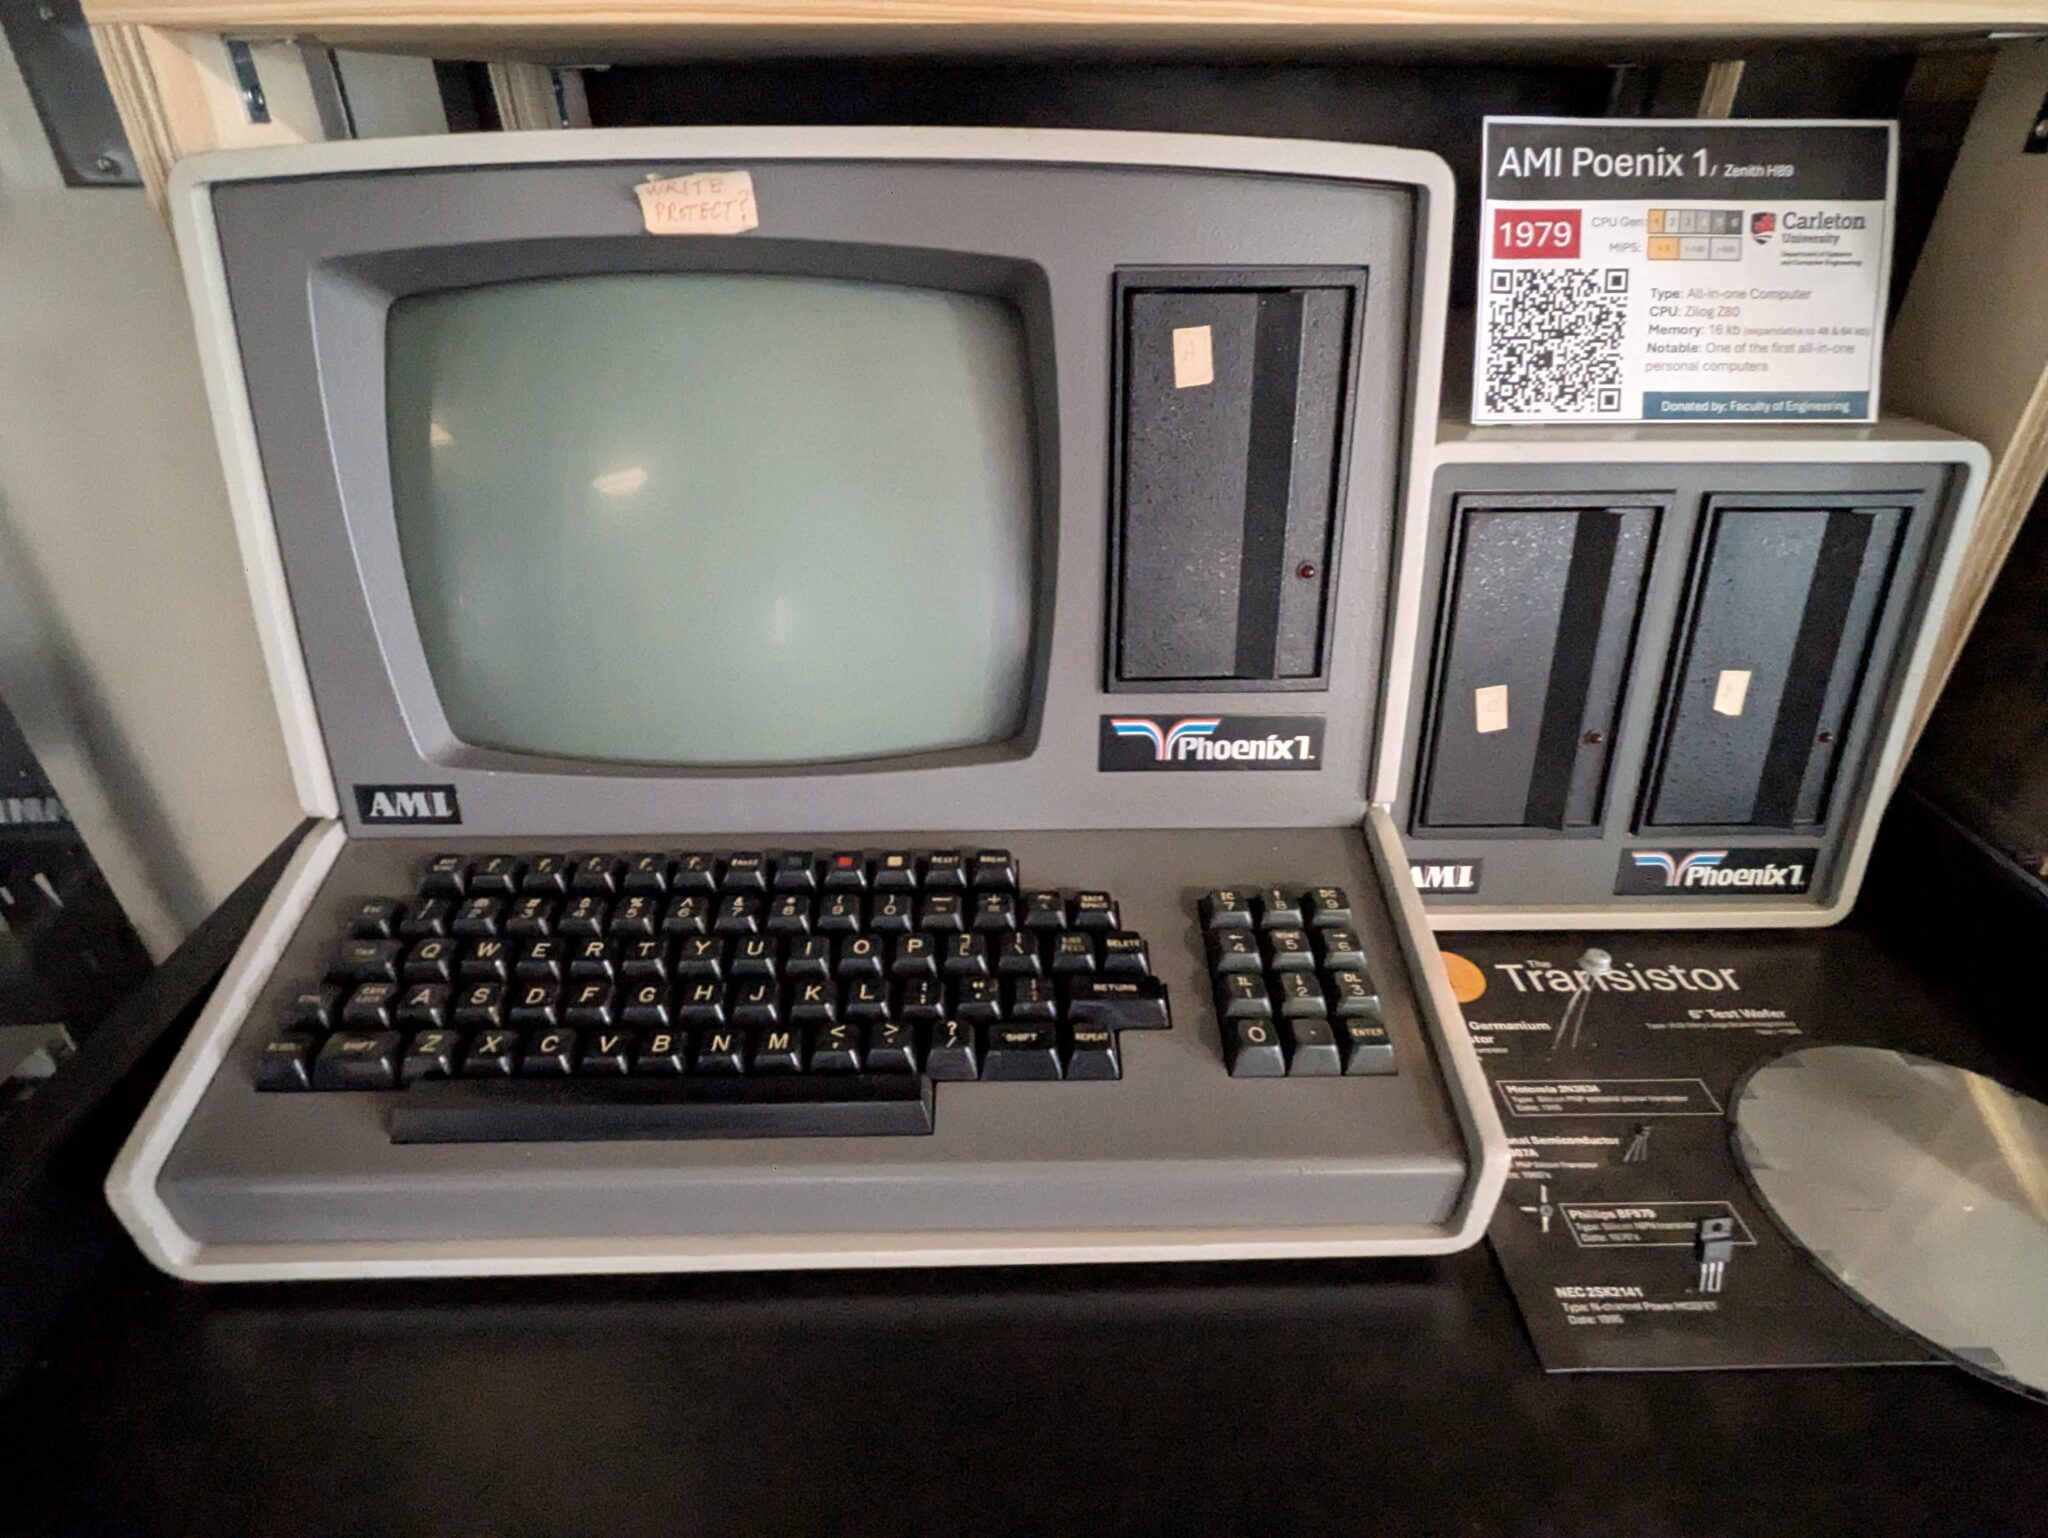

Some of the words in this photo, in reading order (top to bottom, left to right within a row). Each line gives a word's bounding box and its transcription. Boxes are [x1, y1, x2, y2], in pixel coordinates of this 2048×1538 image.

[1498, 147, 1562, 177] AMI
[1572, 146, 1684, 177] Poenix
[1723, 163, 1765, 177] Zenith
[1766, 164, 1795, 177] H89
[646, 178, 724, 196] WRITE
[1591, 216, 1618, 228] CPU
[1782, 210, 1866, 230] Carleton
[1499, 221, 1572, 248] 1979
[1781, 233, 1840, 246] University
[1609, 242, 1641, 253] MIPS:
[1650, 288, 1684, 300] Type:
[1688, 288, 1746, 299] All-in-one
[1750, 288, 1812, 301] Computer
[1649, 306, 1682, 317] CPU:
[1685, 306, 1714, 319] Zilog
[1717, 306, 1741, 317] Z80
[1648, 325, 1704, 338] Memory:
[1646, 342, 1701, 354] Notable:
[1706, 343, 1730, 354] One
[1735, 342, 1747, 354] of
[1749, 342, 1768, 354] the
[1772, 342, 1794, 354] first
[1645, 361, 1699, 373] personal
[1703, 362, 1769, 373] computers
[1661, 401, 1709, 412] Donated
[1711, 401, 1728, 414] by:
[1730, 401, 1771, 414] Faculty
[1773, 401, 1784, 412] of
[1786, 401, 1851, 414] Engineering
[369, 791, 453, 817] AMI
[931, 855, 959, 864] RESET
[731, 907, 744, 916] 7
[1223, 902, 1235, 911] 7
[1325, 899, 1340, 909] 9
[625, 908, 639, 918] 5
[677, 908, 690, 918] 6
[420, 943, 442, 958] Q
[476, 942, 501, 957] W
[531, 942, 551, 958] E
[585, 942, 604, 957] R
[638, 942, 656, 957] T
[695, 940, 711, 955] Y
[747, 940, 764, 955] U
[804, 941, 812, 955] I
[853, 939, 870, 955] O
[907, 938, 924, 953] P
[1106, 938, 1141, 948] DELETE
[1233, 943, 1246, 952] 4
[1285, 940, 1298, 950] 5
[1338, 942, 1351, 952] 6
[1526, 959, 1552, 968] The
[1494, 962, 1741, 992] Transistor
[580, 987, 600, 1002] F
[638, 987, 657, 1002] G
[693, 984, 714, 1000] H
[749, 985, 765, 1001] J
[804, 985, 823, 1000] K
[859, 984, 875, 999] L
[1092, 983, 1138, 992] RETURN
[1296, 986, 1309, 997] 2
[1351, 985, 1365, 995] 3
[411, 988, 431, 1004] A
[471, 988, 491, 1003] S
[525, 988, 545, 1004] D
[1352, 1027, 1384, 1036] ENTER
[1468, 1021, 1551, 1031] Germanium
[419, 1035, 443, 1052] Z
[540, 1036, 560, 1052] C
[651, 1035, 671, 1052] B
[711, 1035, 731, 1052] N
[768, 1033, 789, 1050] M
[1005, 1032, 1038, 1042] SHIFT
[1075, 1032, 1108, 1041] REPEAT
[479, 1036, 503, 1053] X
[600, 1036, 619, 1053] V
[1530, 1136, 1620, 1145] Semiconductor
[1554, 1286, 1586, 1298] NEC
